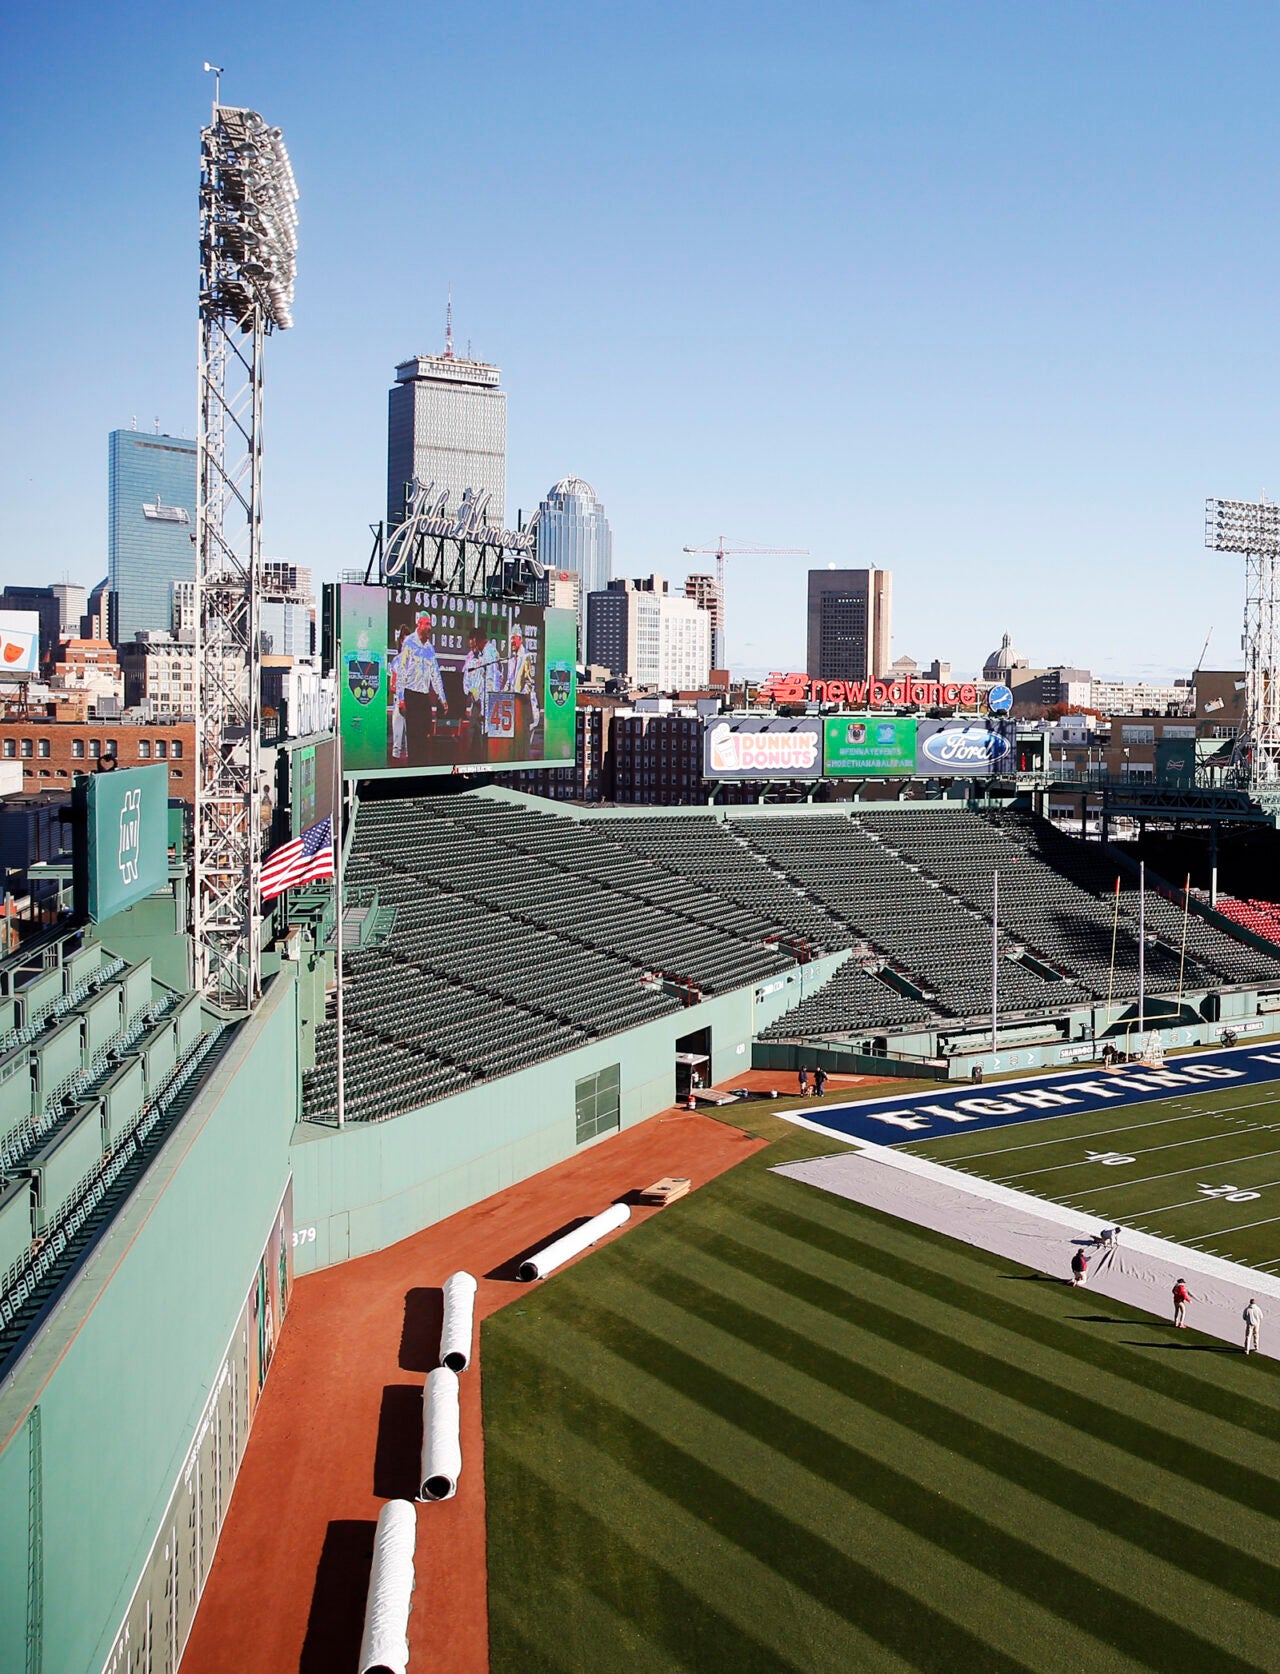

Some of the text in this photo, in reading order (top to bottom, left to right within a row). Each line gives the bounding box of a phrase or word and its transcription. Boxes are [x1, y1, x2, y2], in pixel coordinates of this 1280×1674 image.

[382, 477, 544, 579] John Hancock
[810, 679, 867, 703] new
[869, 675, 977, 706] balance
[490, 700, 512, 731] 45
[742, 736, 815, 750] DUNKIN'
[941, 734, 994, 761] Ford
[742, 751, 812, 766] DONUTS
[867, 1061, 1249, 1131] FIGHTING
[1201, 1185, 1261, 1202] 20
